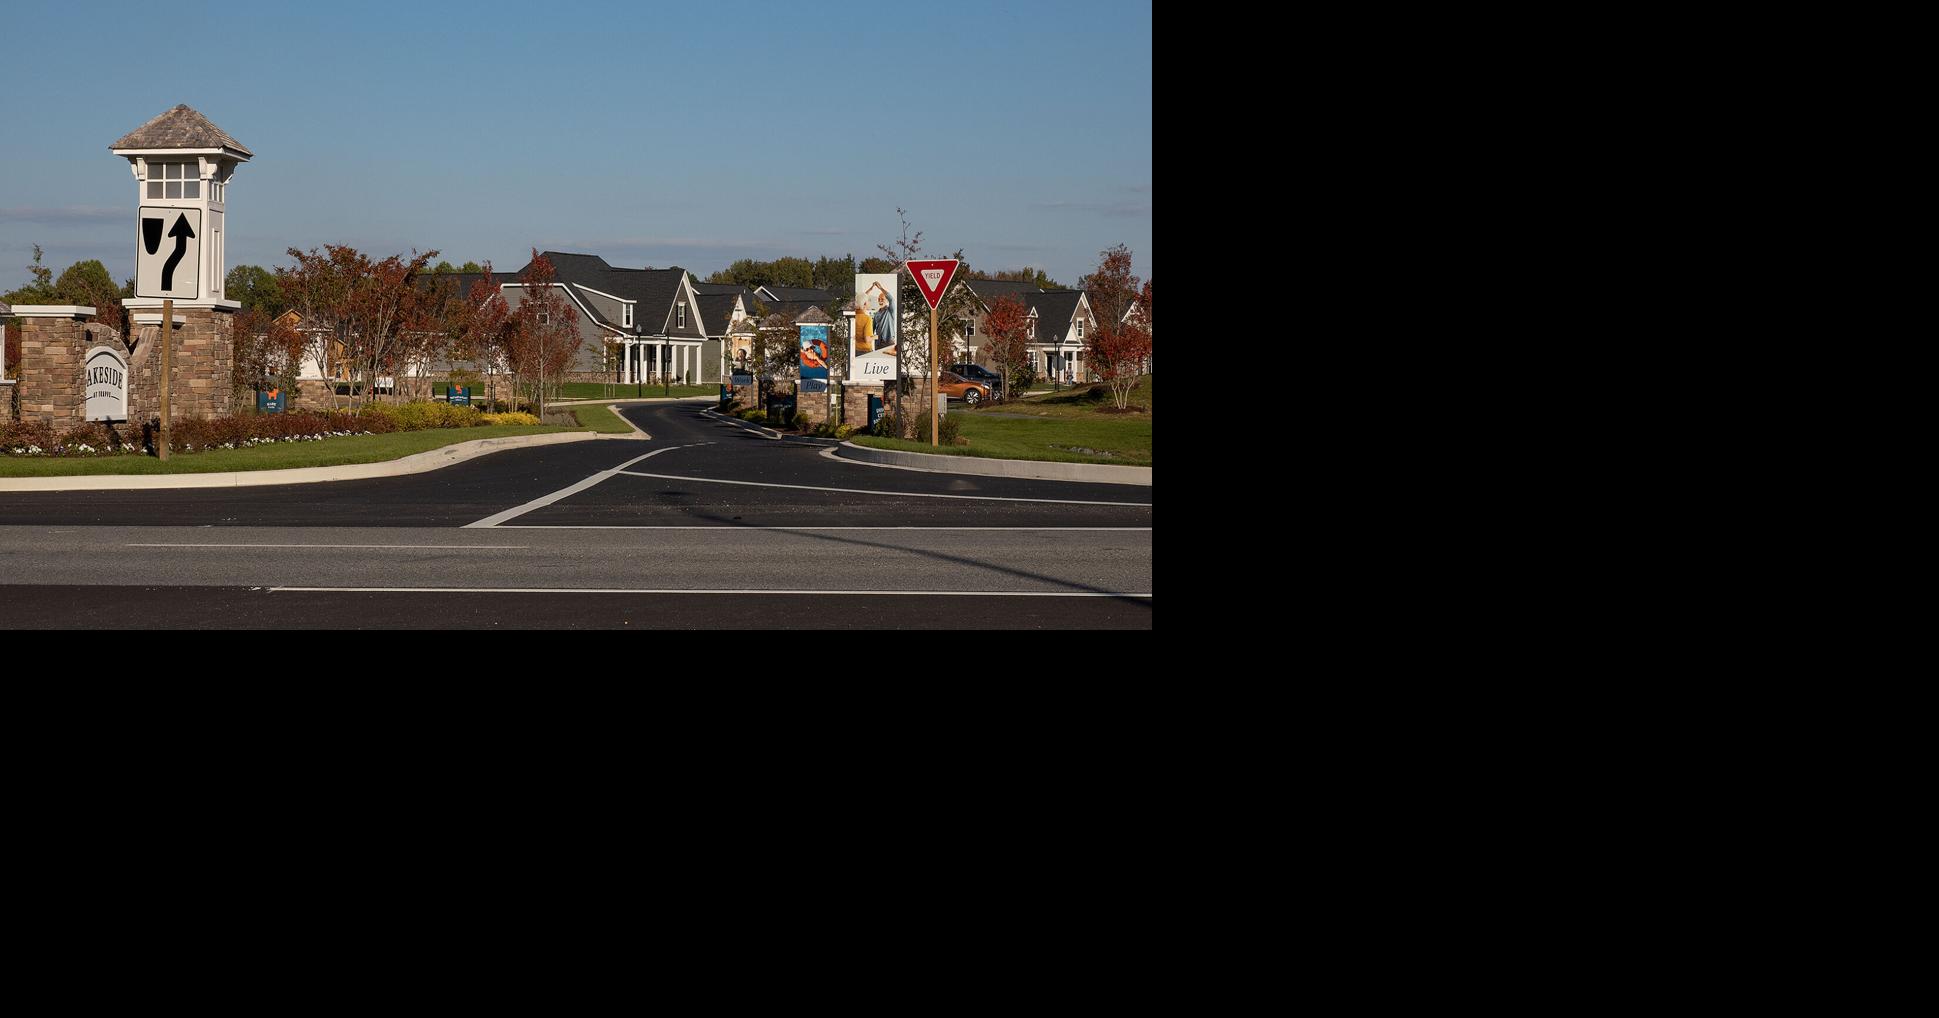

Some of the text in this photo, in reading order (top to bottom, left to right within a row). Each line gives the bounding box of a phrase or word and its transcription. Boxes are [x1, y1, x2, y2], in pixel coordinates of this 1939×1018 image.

[924, 272, 941, 280] YIELD
[864, 362, 889, 375] Live
[86, 366, 122, 390] AKESIDE
[805, 381, 823, 391] Play
